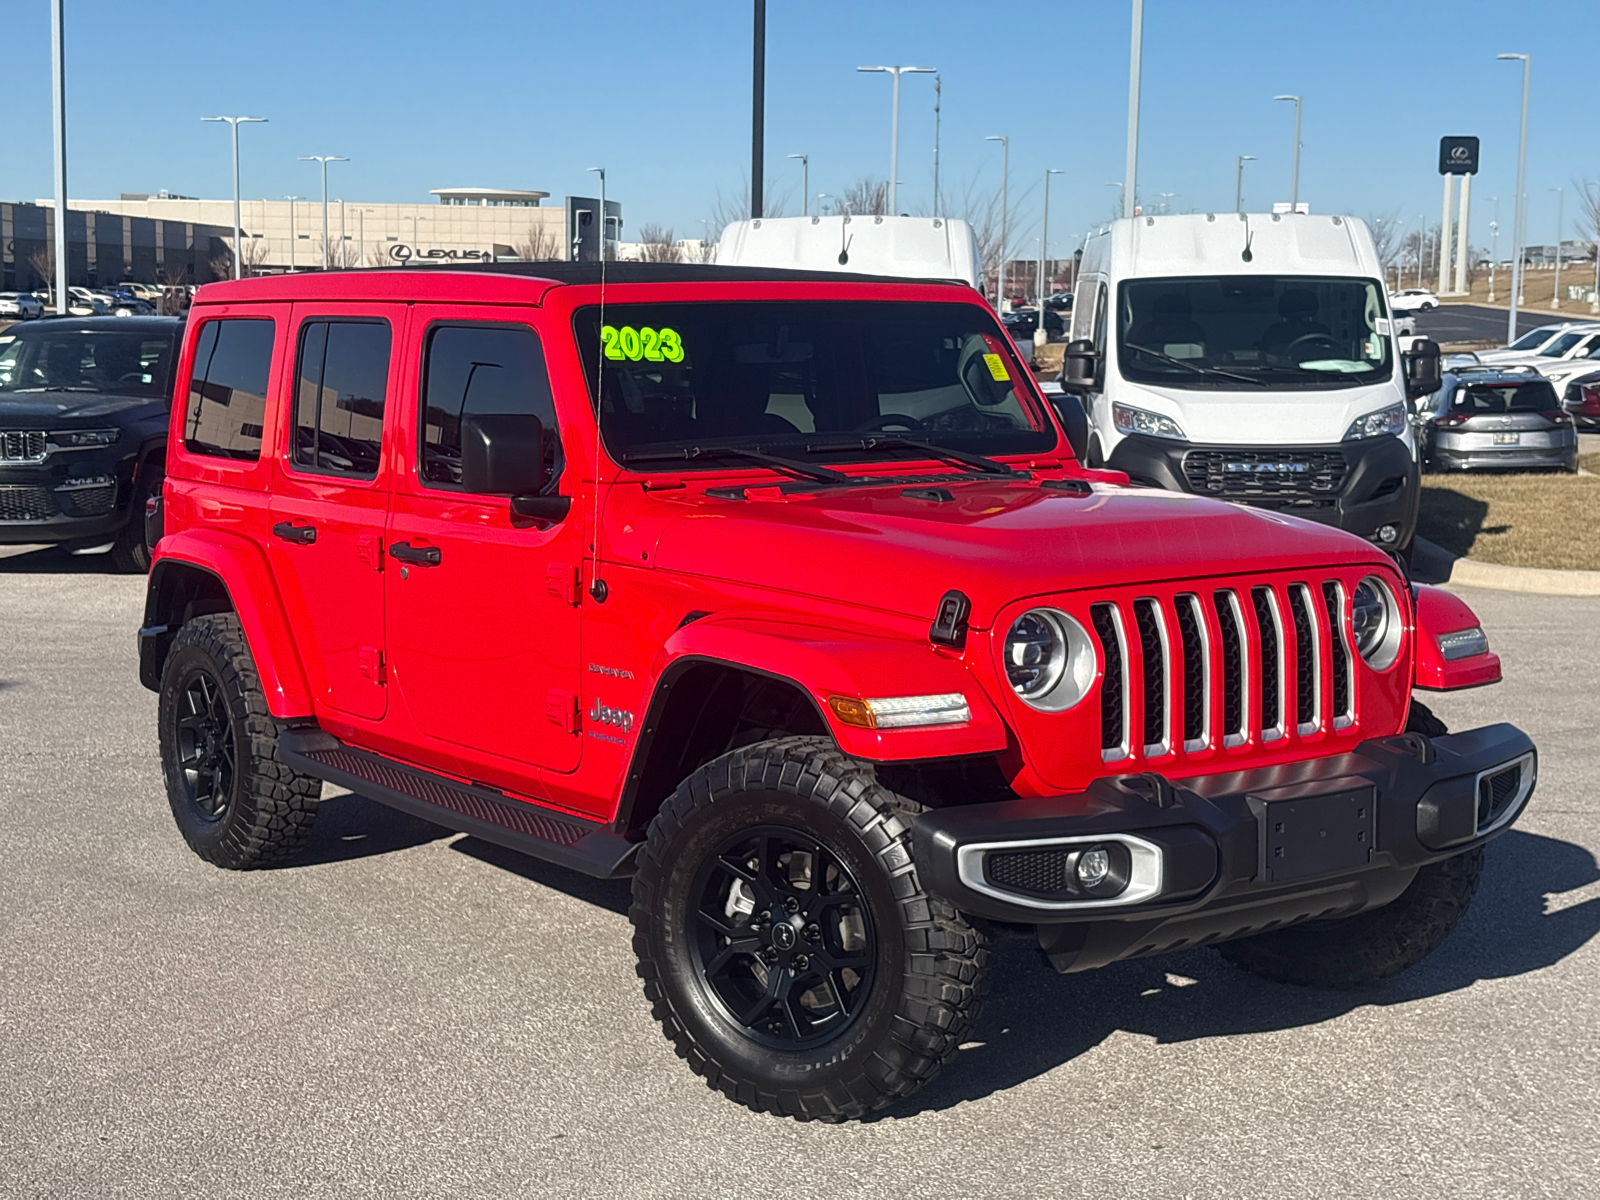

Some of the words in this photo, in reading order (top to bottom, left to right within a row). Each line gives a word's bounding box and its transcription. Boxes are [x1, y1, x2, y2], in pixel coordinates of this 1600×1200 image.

[416, 248, 481, 260] LEXUS
[601, 325, 685, 363] 2023
[1227, 462, 1304, 473] RAM
[588, 663, 635, 680] SAHARA
[588, 697, 635, 734] Jeep
